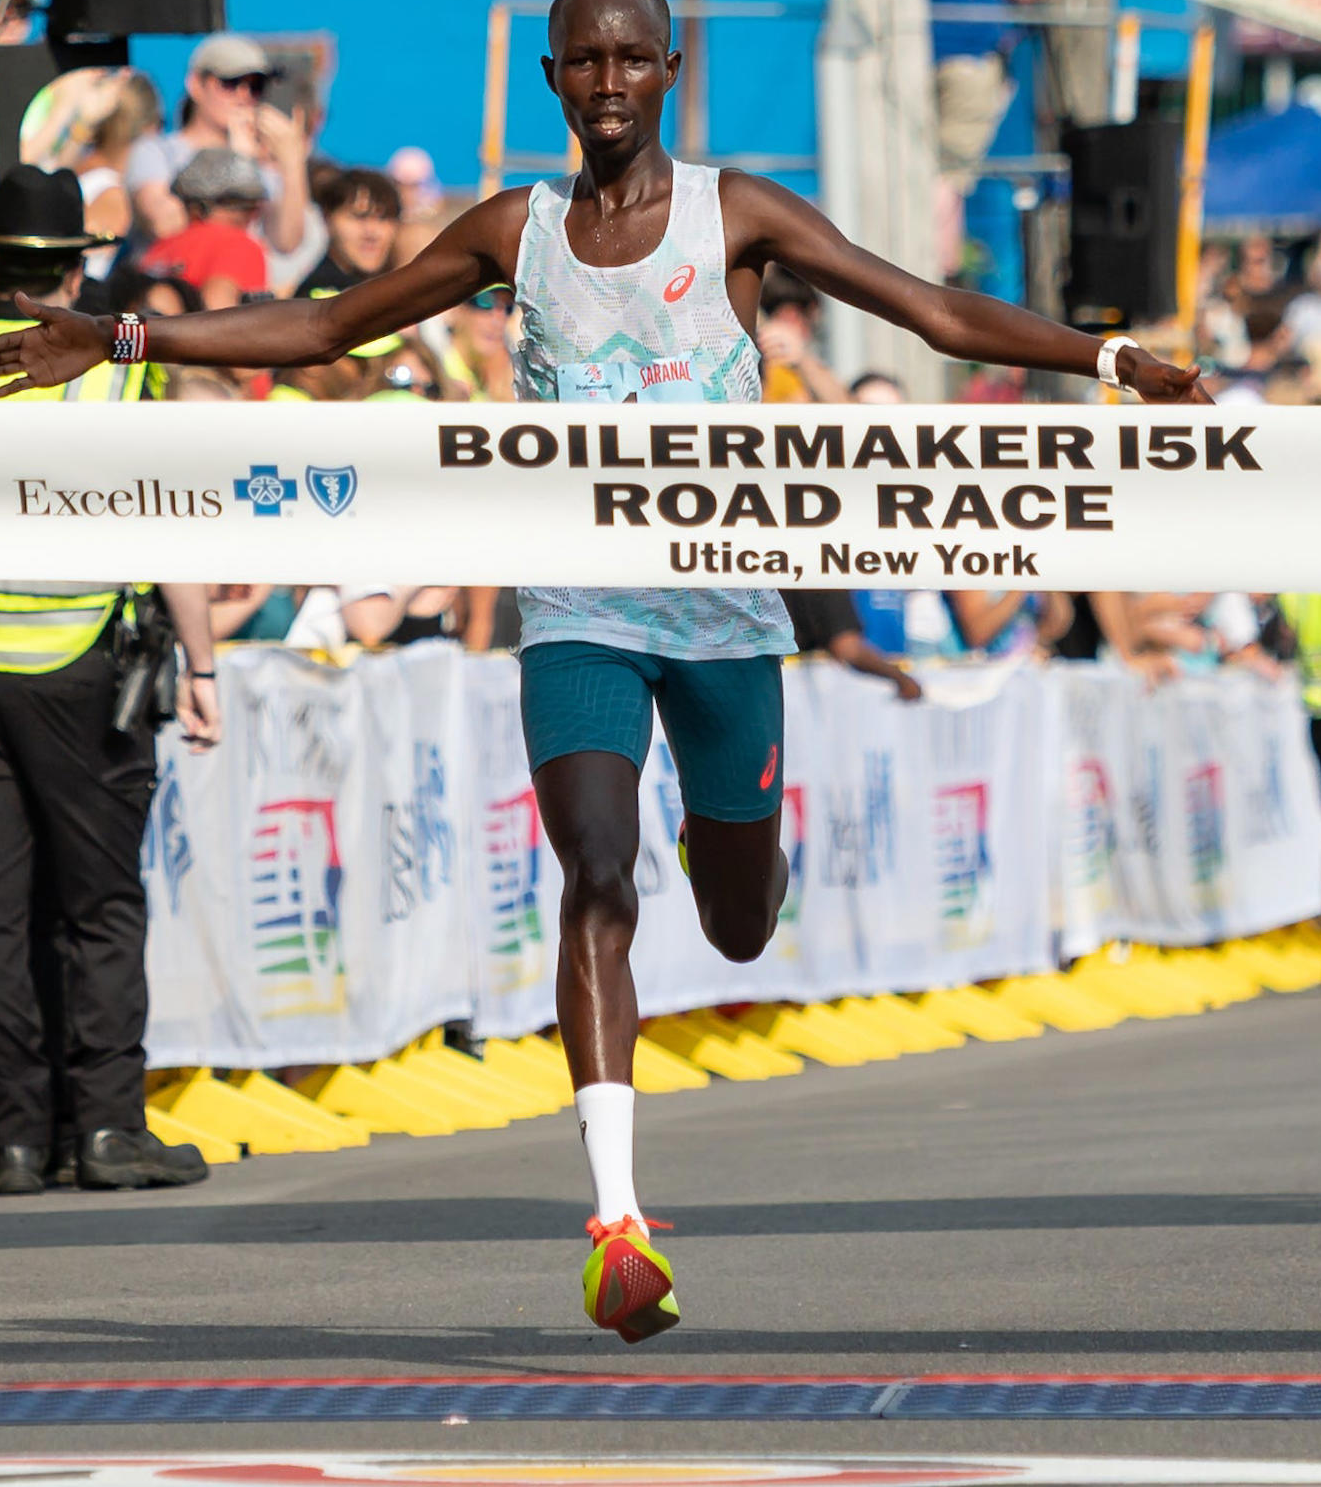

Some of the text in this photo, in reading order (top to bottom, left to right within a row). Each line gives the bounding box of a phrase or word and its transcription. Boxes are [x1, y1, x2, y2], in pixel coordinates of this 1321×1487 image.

[639, 360, 693, 390] SARANAC
[438, 423, 1095, 470] BOILERMAKER
[13, 478, 223, 518] Excellus
[592, 482, 1114, 531] ROAD RACE
[669, 541, 1039, 582] Utica, New York
